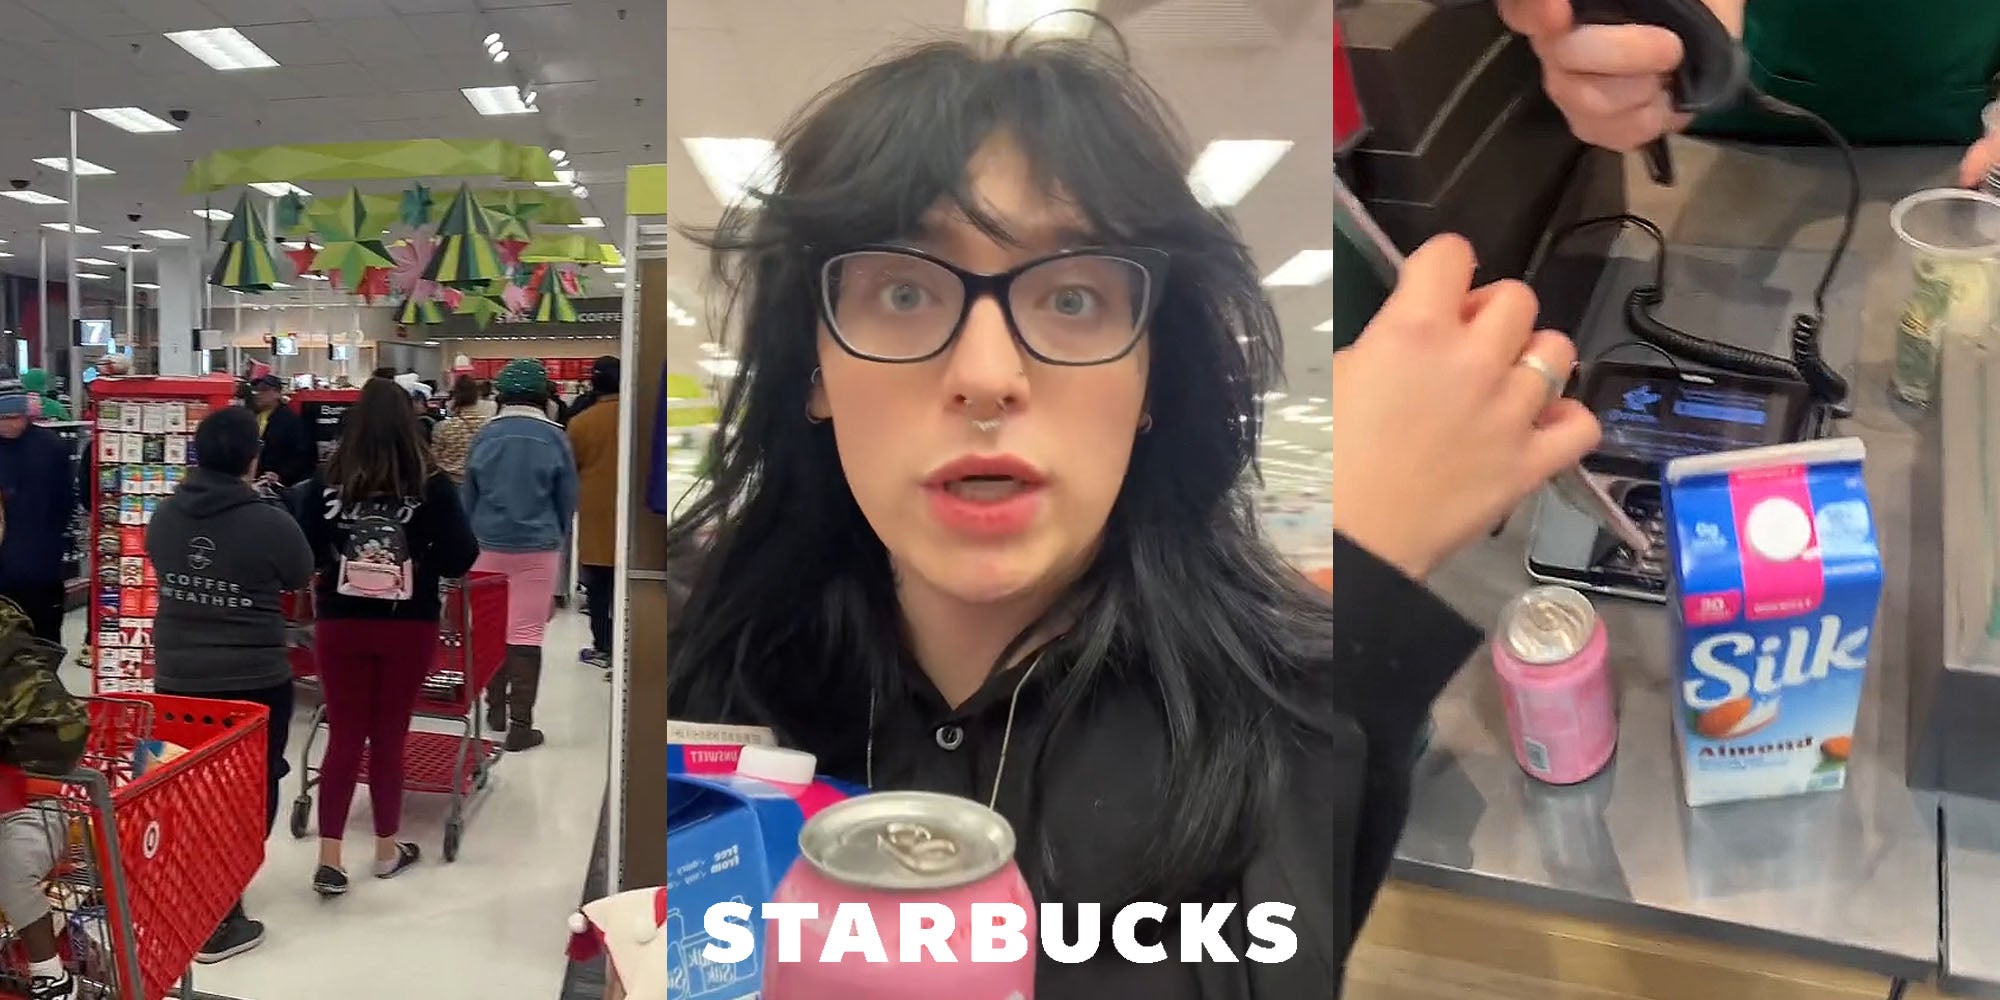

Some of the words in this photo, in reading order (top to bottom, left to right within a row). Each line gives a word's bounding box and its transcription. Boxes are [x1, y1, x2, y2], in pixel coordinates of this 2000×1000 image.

[578, 312, 623, 322] COFFE
[88, 322, 105, 343] 7
[165, 573, 240, 593] COFFEE
[1683, 614, 1868, 710] Silk
